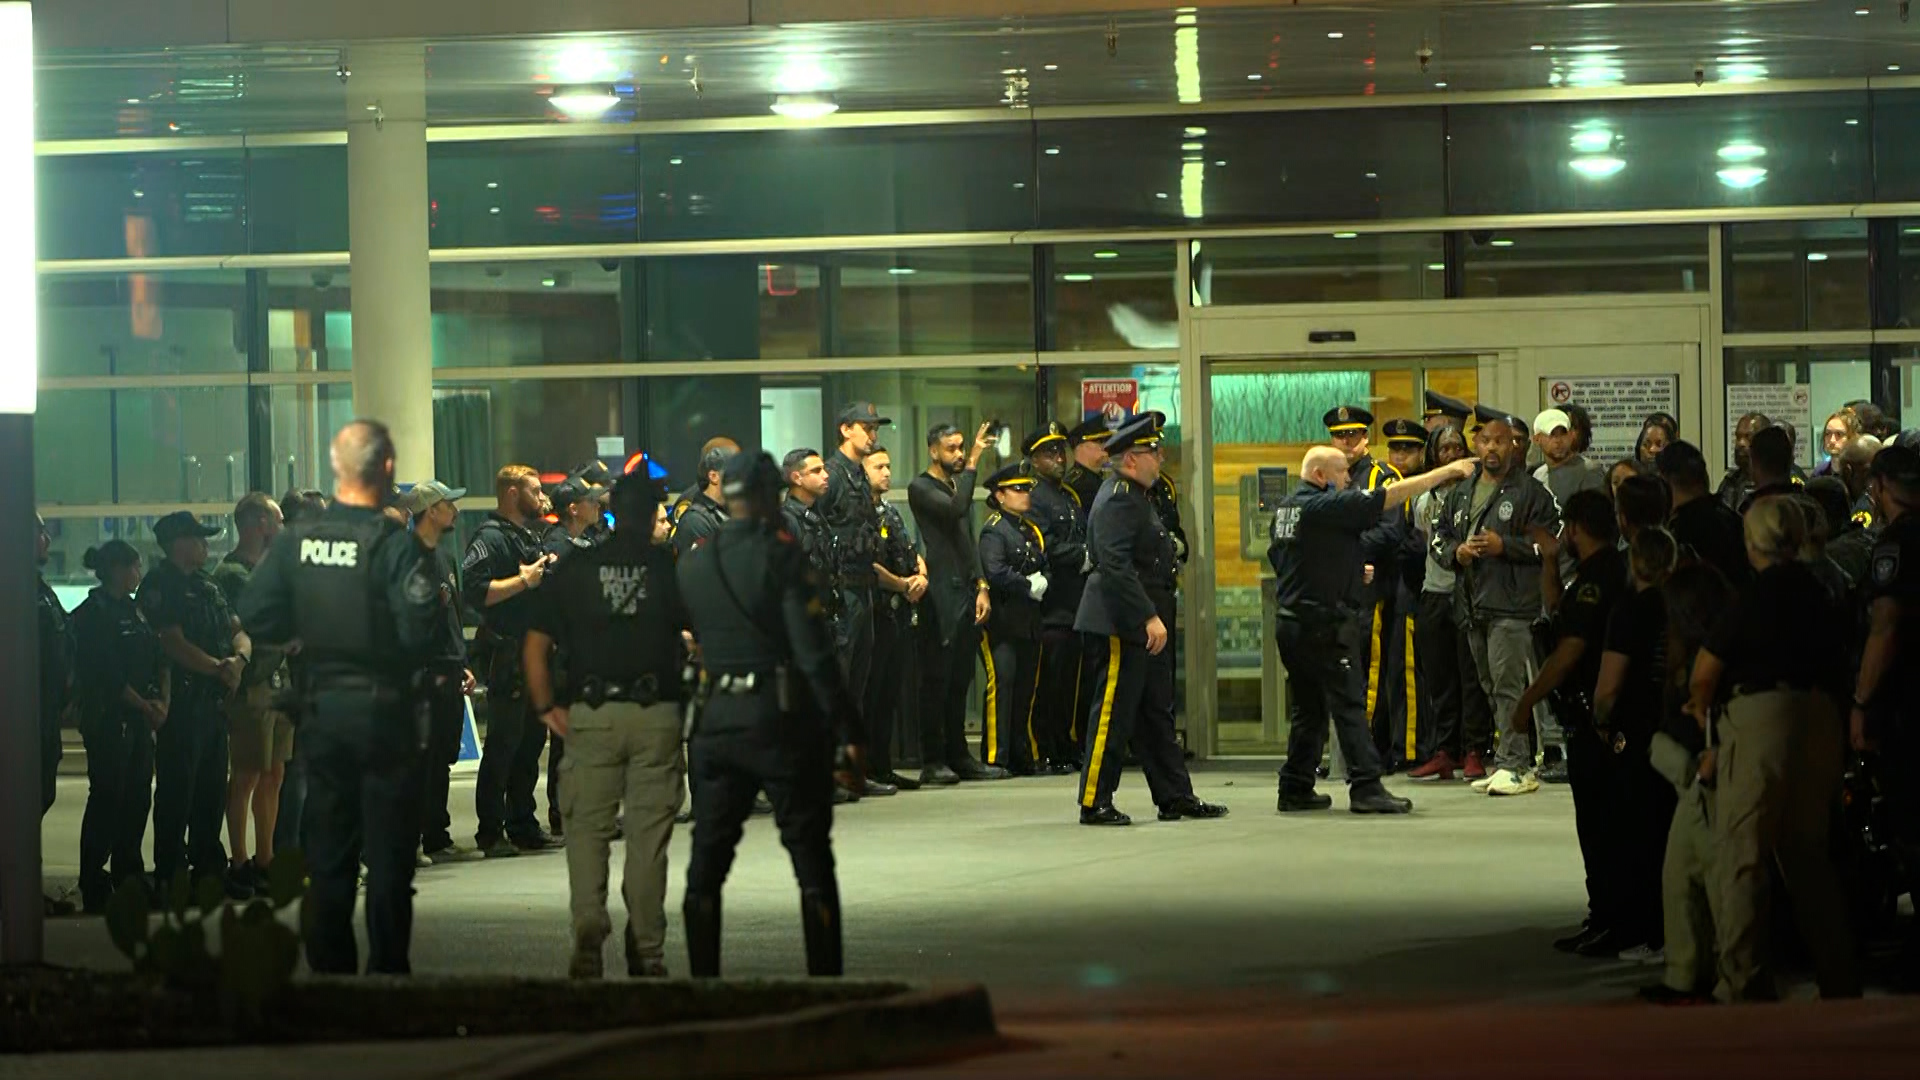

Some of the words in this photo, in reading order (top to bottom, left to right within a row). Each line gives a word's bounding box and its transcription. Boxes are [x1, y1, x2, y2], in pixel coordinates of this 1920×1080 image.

[1088, 383, 1132, 394] ATTENTION
[300, 539, 358, 567] POLICE
[602, 580, 648, 599] POLIE
